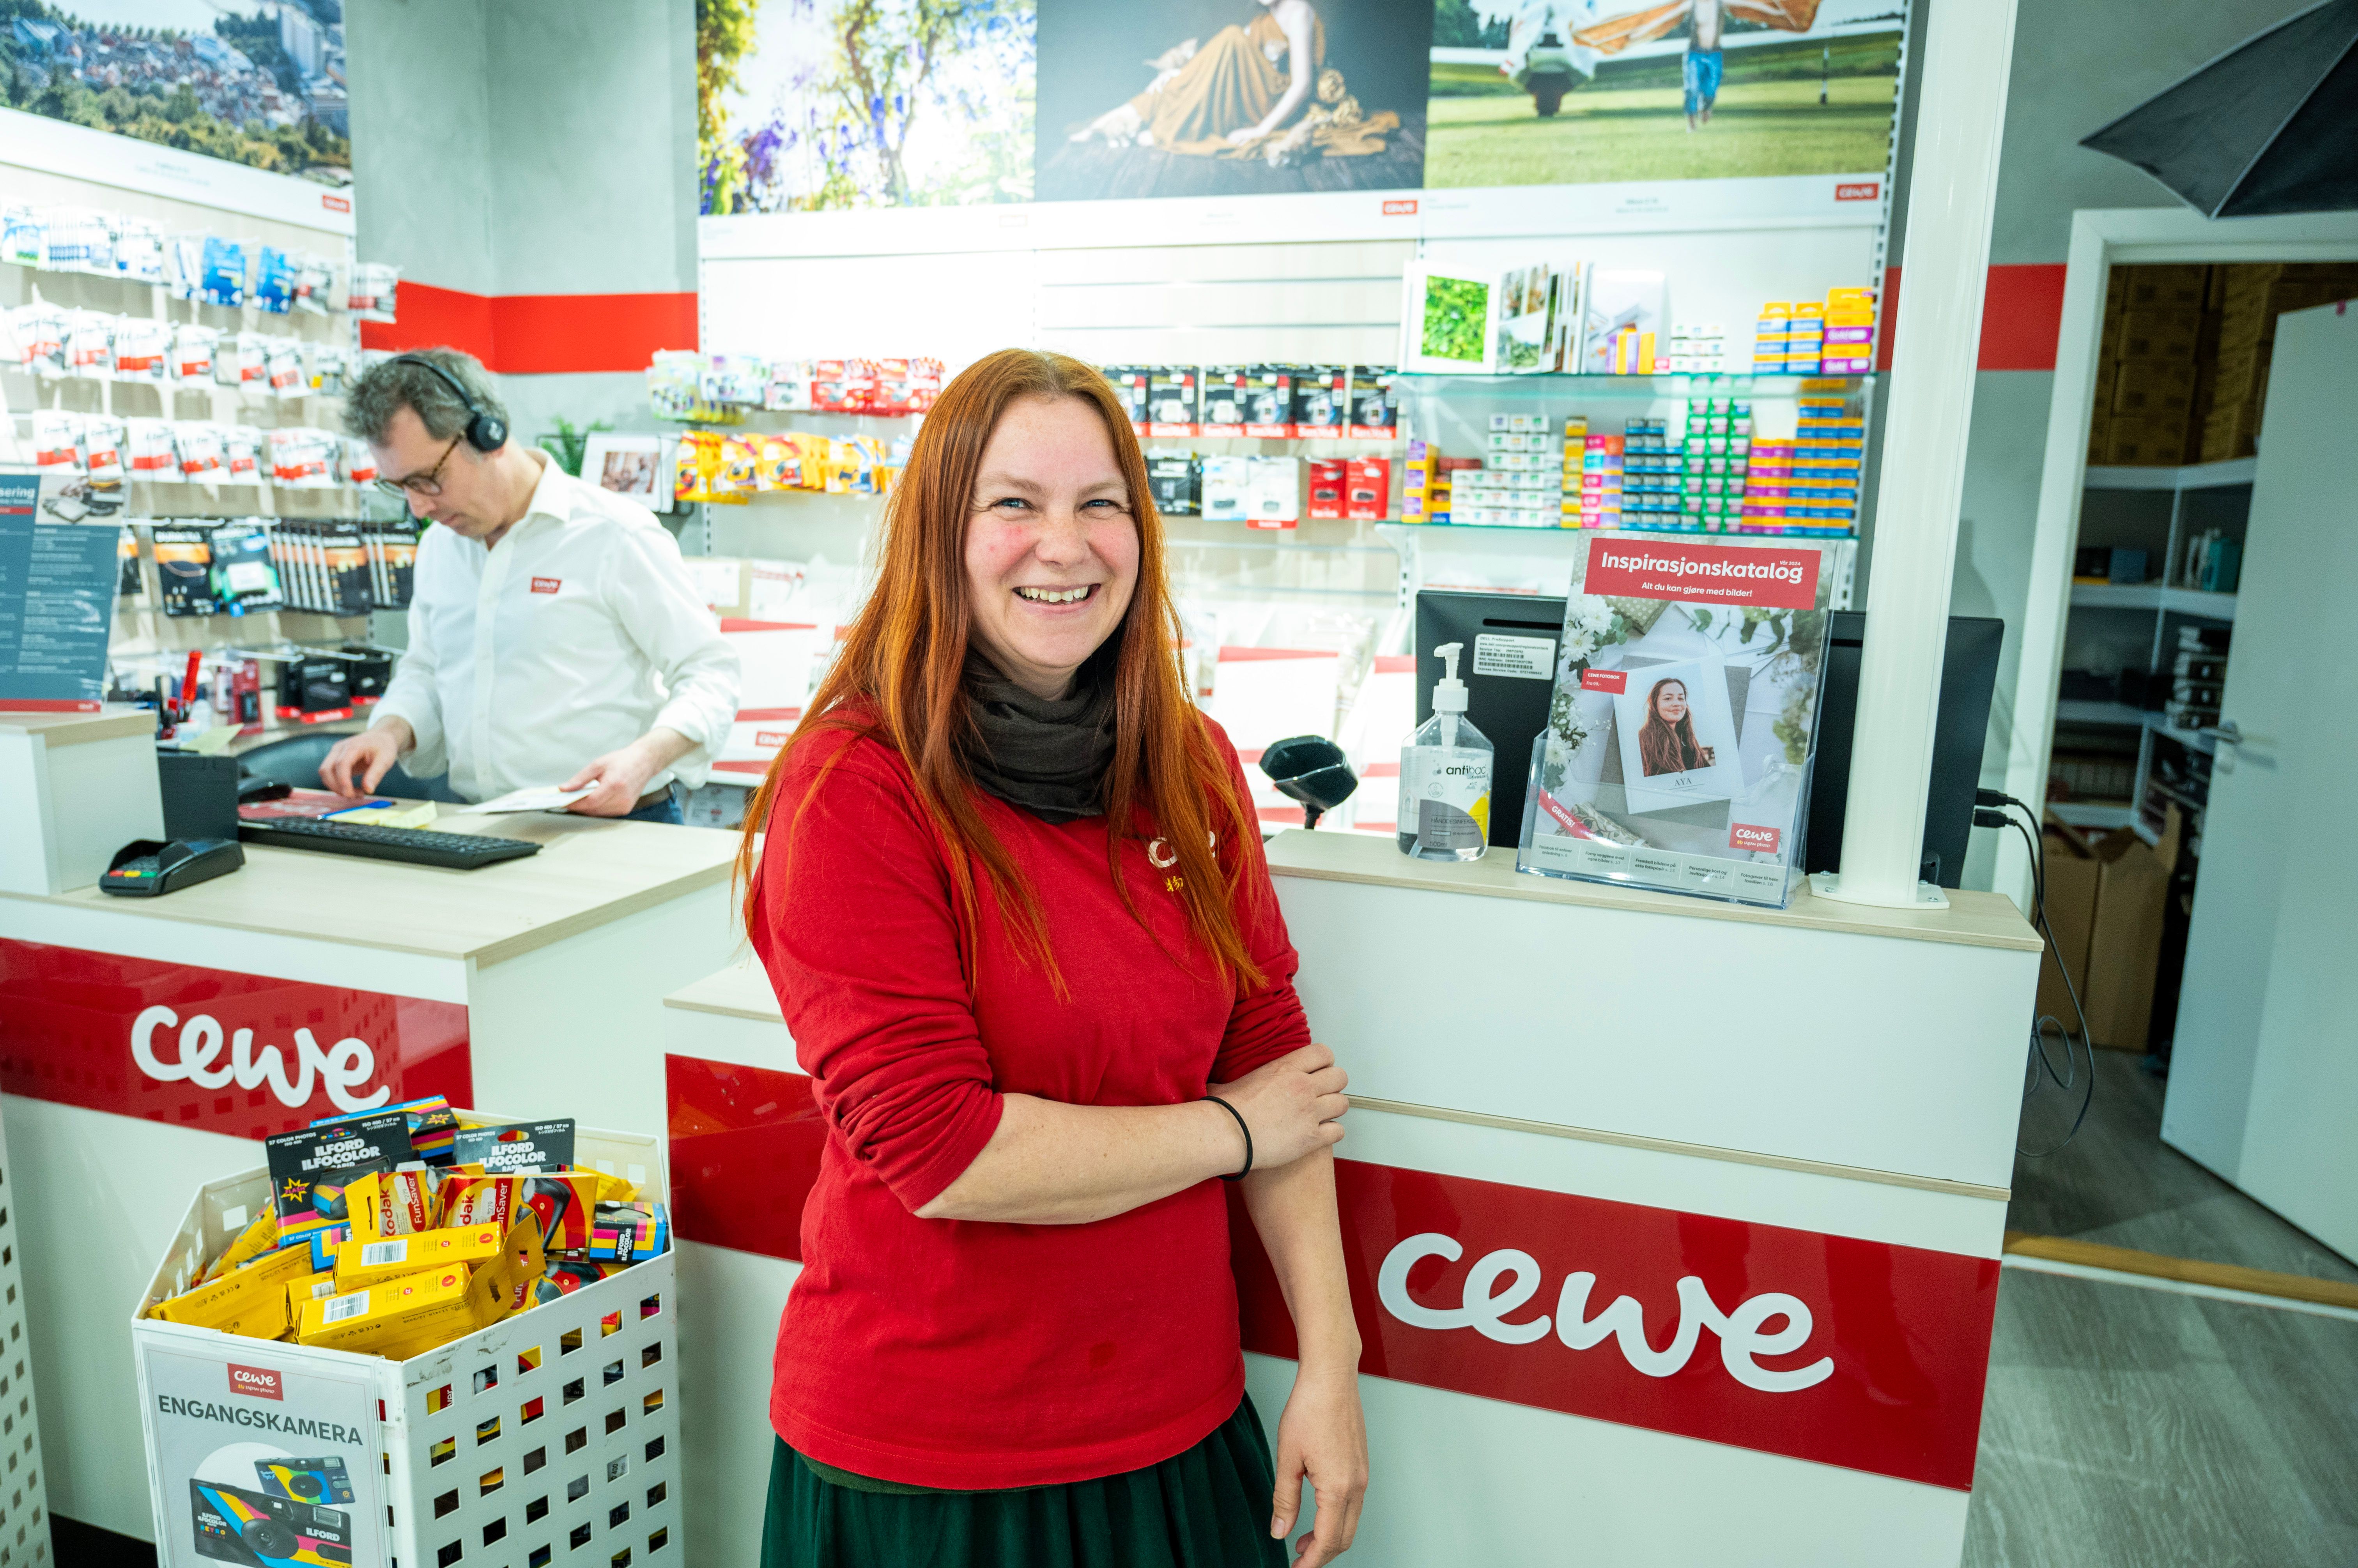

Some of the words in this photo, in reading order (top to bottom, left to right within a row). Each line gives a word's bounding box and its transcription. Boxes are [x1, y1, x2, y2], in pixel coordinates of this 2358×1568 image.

[1601, 552, 1804, 584] Inspirasjonskatalog
[1641, 582, 1653, 590] Alt
[1654, 583, 1665, 591] du
[1666, 584, 1681, 592] kan
[1683, 586, 1704, 595] gjøre
[1706, 587, 1724, 596] med
[1726, 589, 1752, 597] bilder!
[1446, 765, 1486, 775] antibac
[1674, 778, 1692, 787] AYA
[1551, 805, 1575, 828] GRATIS!
[1736, 829, 1774, 841] cewe
[1740, 873, 1763, 881] Fotogaver
[131, 1005, 390, 1114] cewe
[276, 1136, 294, 1145] COLOR
[295, 1132, 317, 1141] PHOTOS
[315, 1138, 365, 1157] ILFORD
[491, 1142, 535, 1156] ILFORD
[301, 1146, 381, 1171] ILFOCOLOR
[479, 1151, 546, 1168] ILFOCOLOR
[502, 1164, 524, 1172] RAPID
[285, 1185, 306, 1194] FLASH
[407, 1176, 422, 1224] FunSaver
[496, 1183, 508, 1227] unSaver
[380, 1188, 396, 1236] Kodak
[460, 1193, 475, 1227] dak
[617, 1233, 625, 1255] ILFORD
[621, 1228, 632, 1261] ILFOCOLOR
[1377, 1232, 1834, 1393] cewe
[234, 1370, 276, 1387] cewe
[159, 1395, 363, 1446] ENGANGSKAMERA
[198, 1516, 227, 1527] ILFOCOLOR
[202, 1512, 221, 1521] ILFORD
[200, 1524, 226, 1535] RETRO
[306, 1527, 340, 1542] ILFORD
